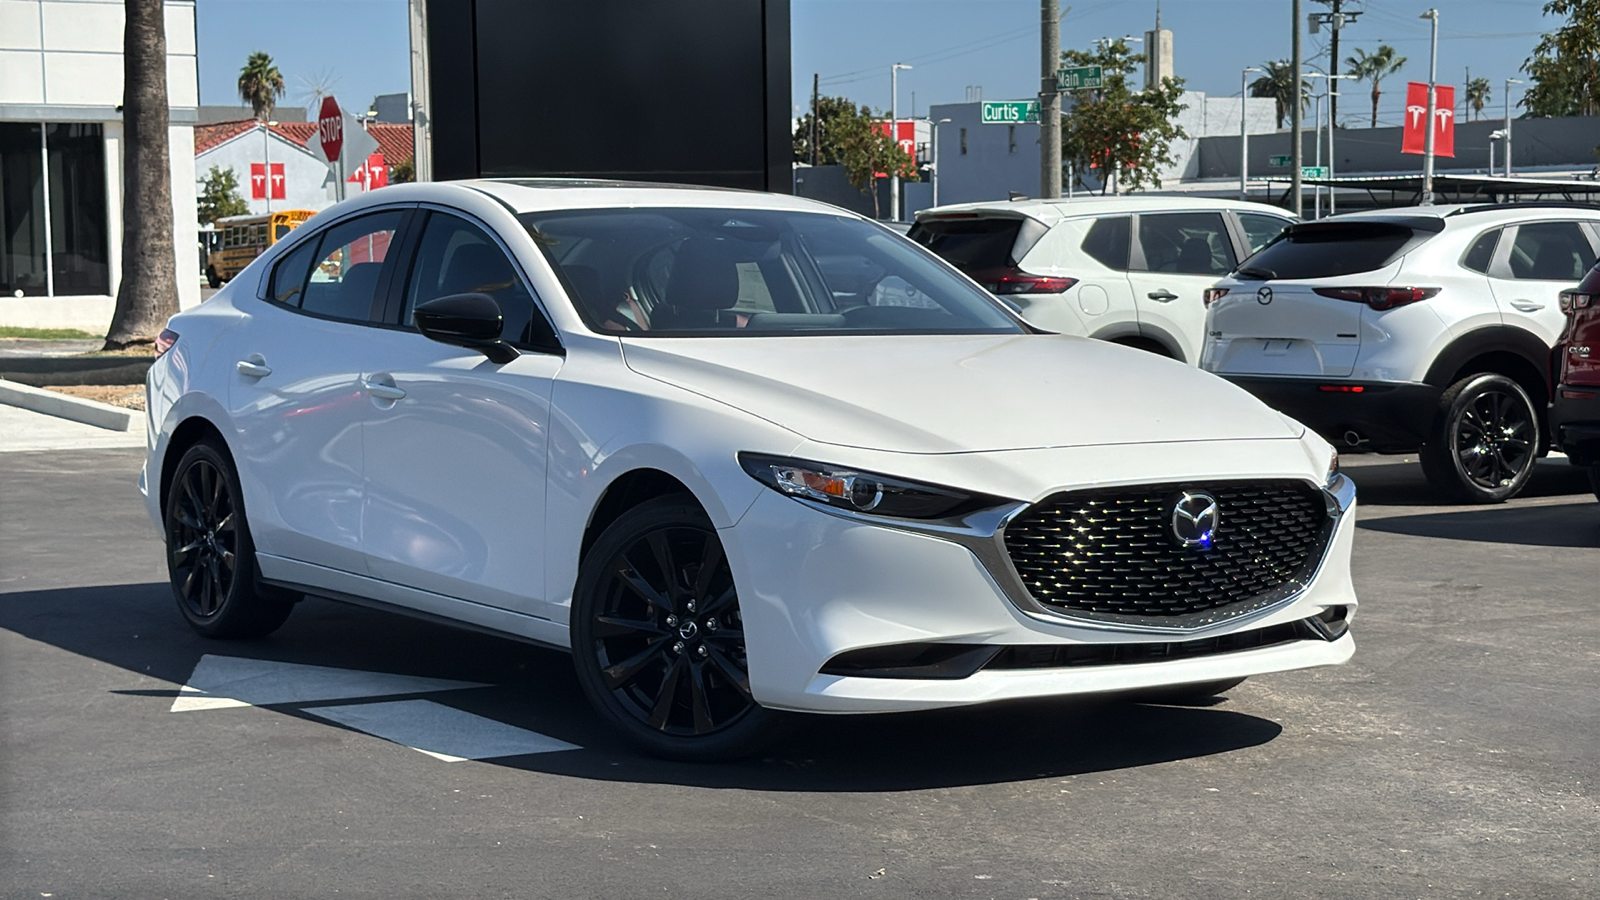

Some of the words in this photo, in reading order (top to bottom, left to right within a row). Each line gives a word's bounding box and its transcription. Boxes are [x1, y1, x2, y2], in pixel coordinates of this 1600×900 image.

[1058, 71, 1079, 88] Main
[984, 103, 1019, 120] Curtis
[320, 116, 342, 143] STOP
